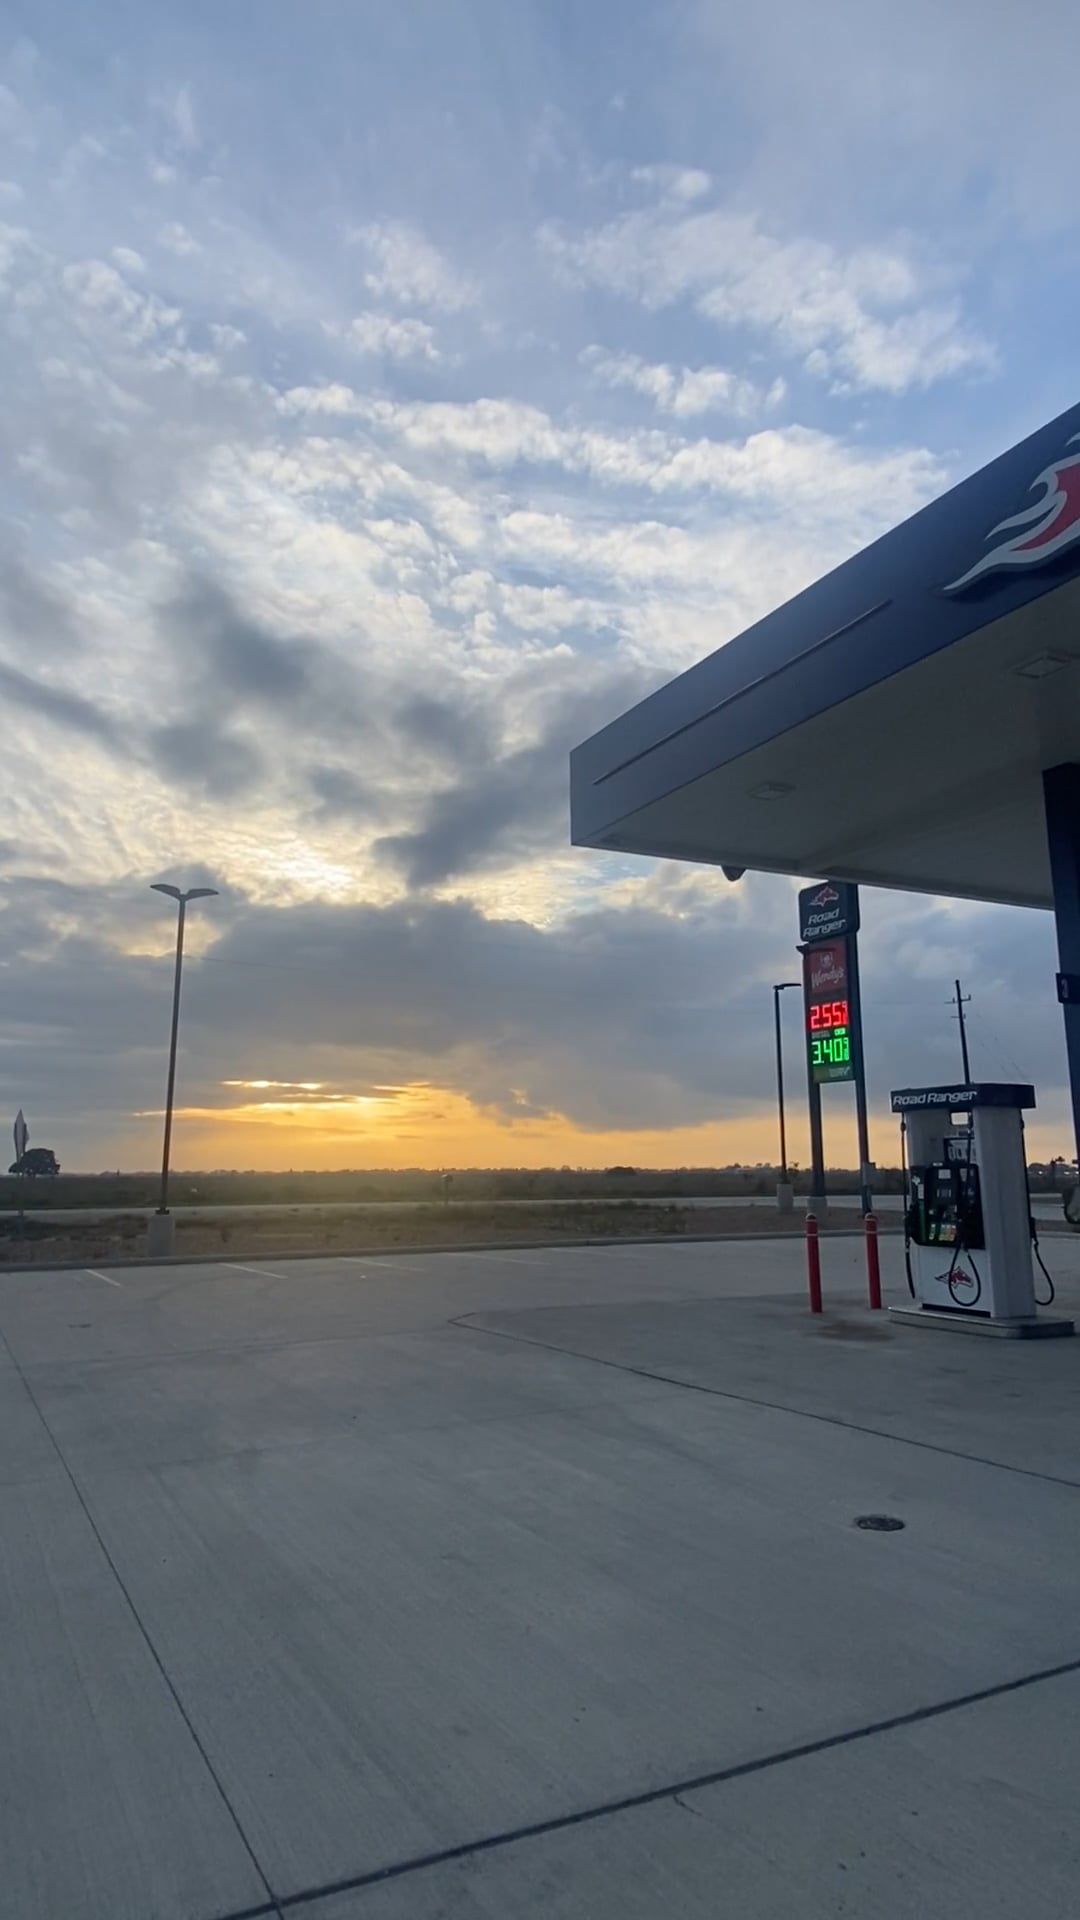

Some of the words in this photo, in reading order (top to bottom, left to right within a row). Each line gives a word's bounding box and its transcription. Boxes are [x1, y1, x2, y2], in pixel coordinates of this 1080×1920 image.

[808, 908, 840, 925] Road
[803, 919, 846, 938] Ranger
[893, 1094, 926, 1106] Road
[927, 1090, 978, 1103] Ranger
